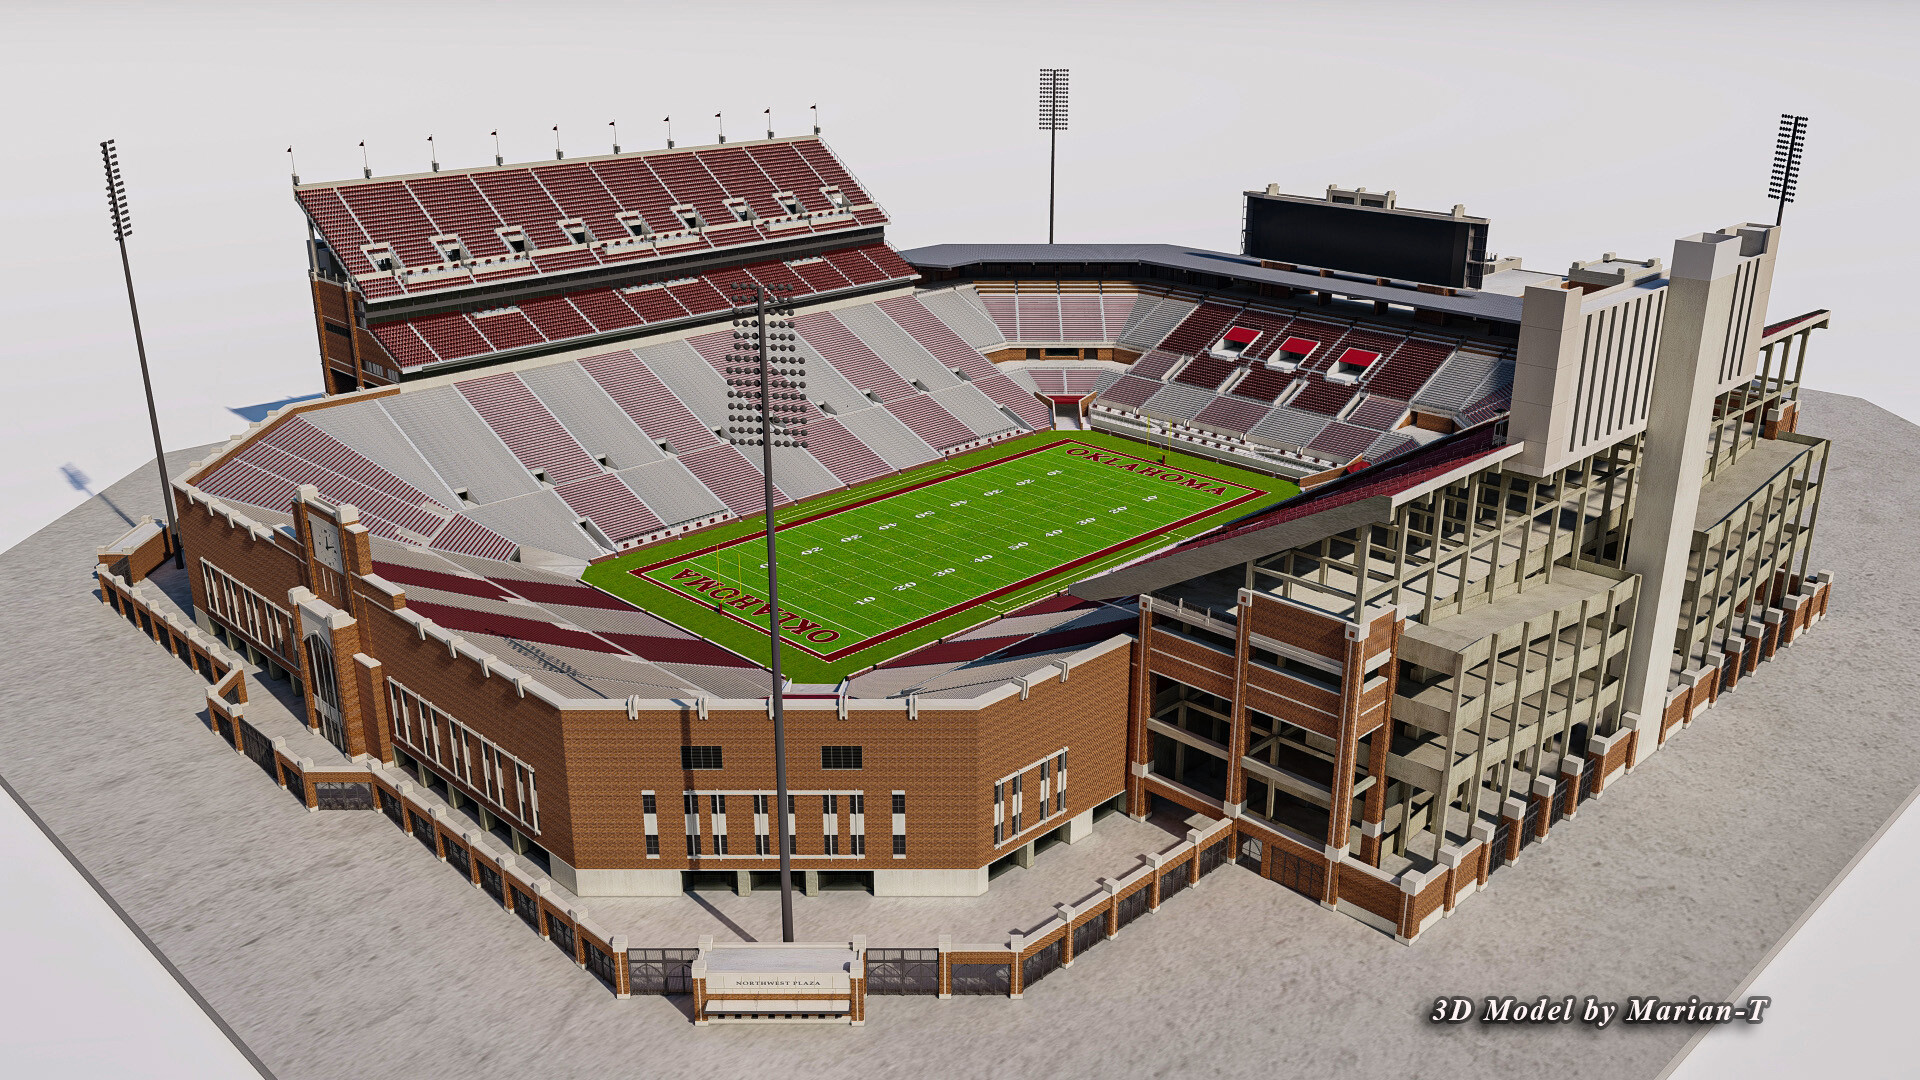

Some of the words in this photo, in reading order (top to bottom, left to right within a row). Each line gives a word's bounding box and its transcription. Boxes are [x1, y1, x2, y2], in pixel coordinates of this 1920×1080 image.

[1066, 448, 1228, 497] OKLAHOMA
[893, 581, 917, 591] 20
[670, 568, 841, 643] OKLAHOMA
[854, 596, 876, 606] 10
